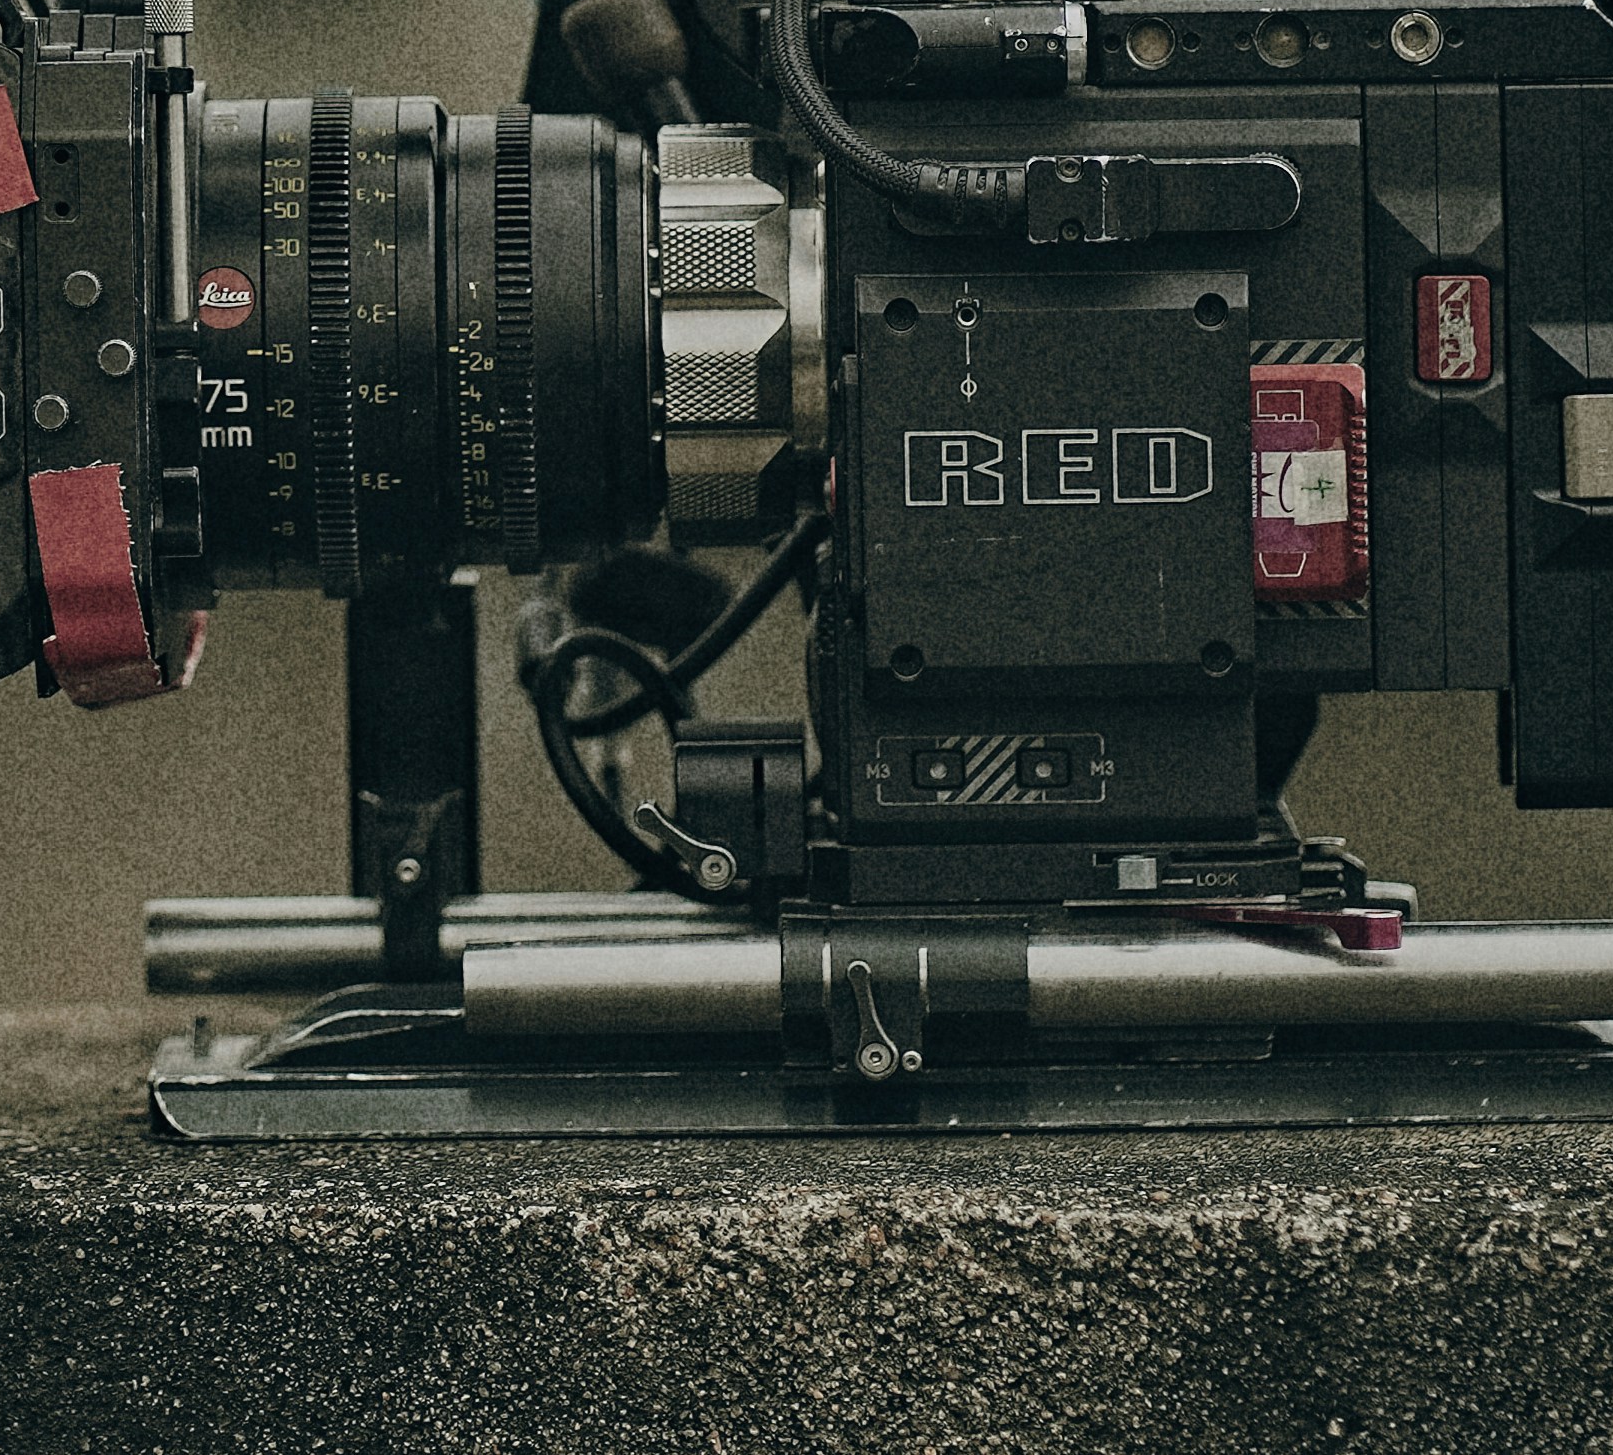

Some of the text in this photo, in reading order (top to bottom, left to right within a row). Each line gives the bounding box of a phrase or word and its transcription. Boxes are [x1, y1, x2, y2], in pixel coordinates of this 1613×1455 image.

[272, 177, 304, 193] 100
[274, 202, 300, 219] 50
[274, 238, 300, 257] 30
[198, 282, 252, 308] Leica
[468, 320, 482, 339] 2
[273, 344, 294, 364] 15
[201, 379, 248, 413] 75
[469, 384, 483, 402] 4
[274, 399, 295, 418] 12
[201, 426, 252, 447] mm
[276, 452, 297, 470] 10
[472, 443, 486, 461] 8
[904, 427, 1213, 506] RED
[279, 485, 293, 501] 9
[865, 762, 891, 779] M3
[1090, 760, 1115, 777] M3
[1196, 872, 1239, 887] LOCK
